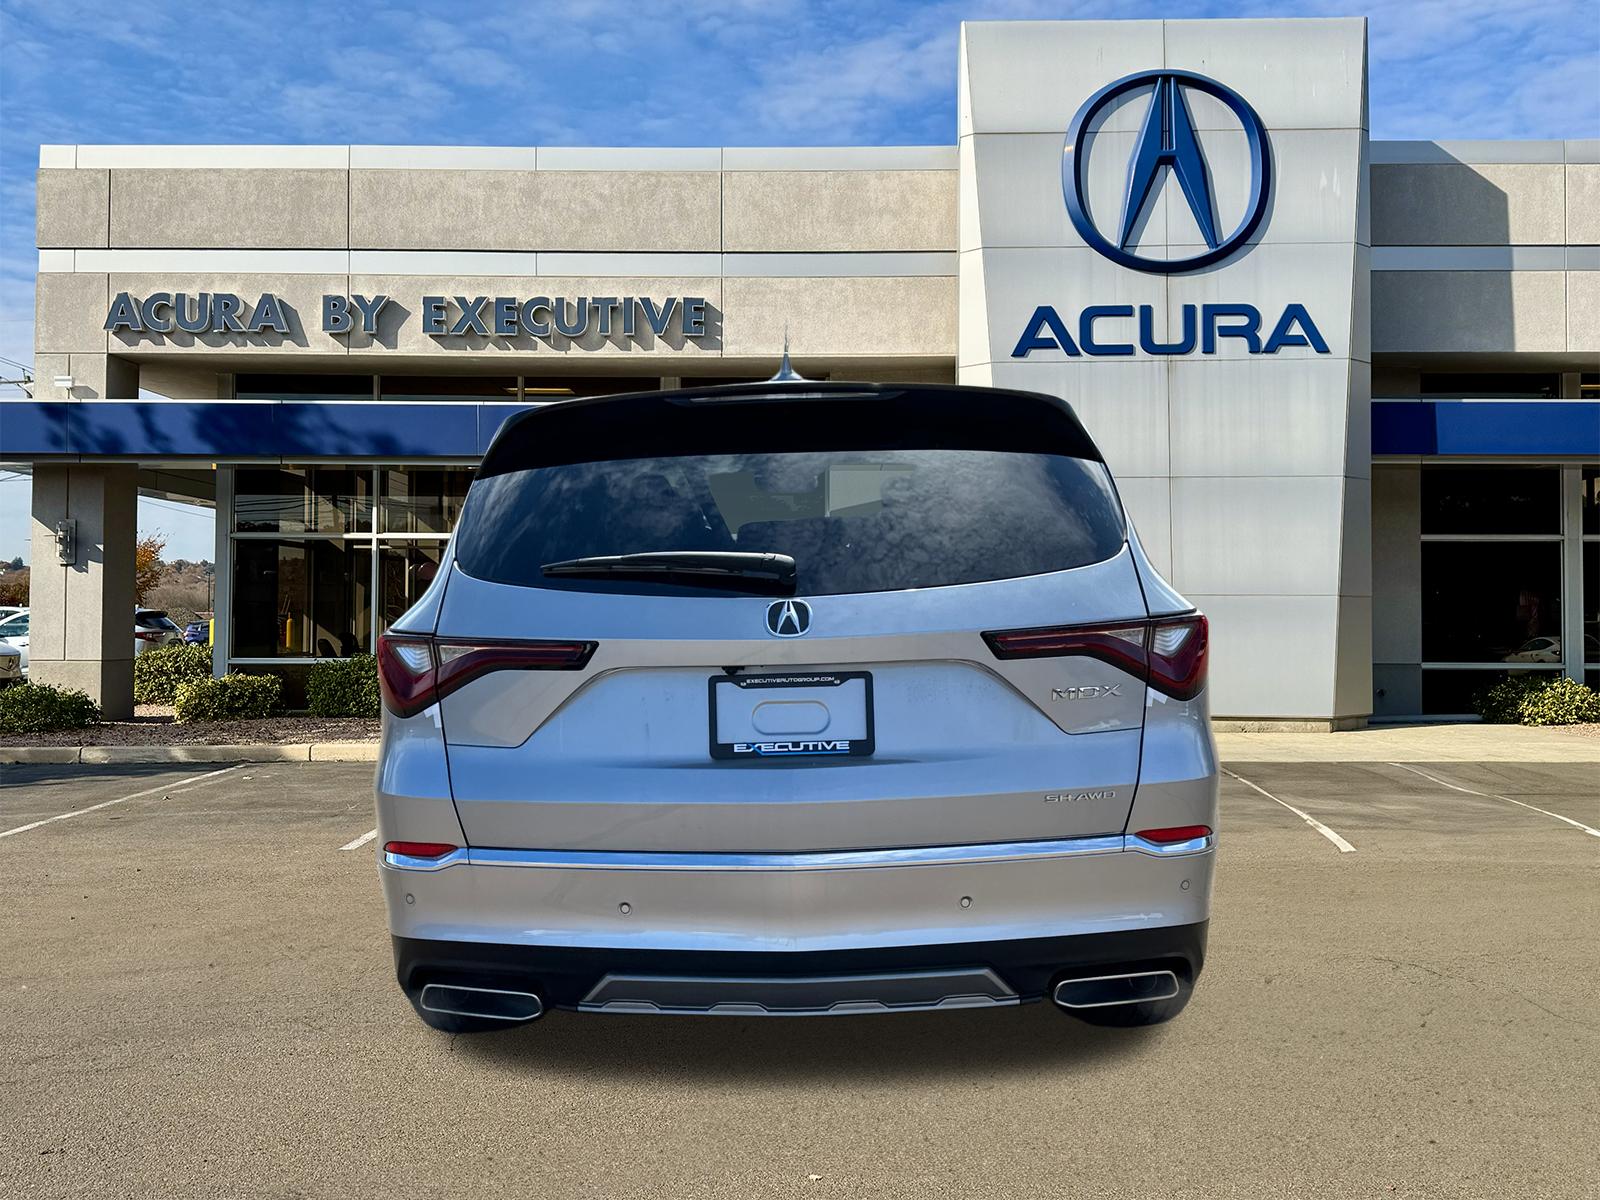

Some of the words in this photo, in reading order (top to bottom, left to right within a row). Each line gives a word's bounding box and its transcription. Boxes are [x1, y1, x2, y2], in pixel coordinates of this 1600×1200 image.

[104, 292, 289, 334] ACURA
[322, 294, 390, 335] BY
[422, 297, 707, 336] EXECUTIVE
[1011, 303, 1331, 357] ACURA
[746, 676, 835, 684] EXECUTIVEAUTOGROUP.COM
[1051, 684, 1122, 701] MDX
[733, 741, 850, 754] EXECUTIVE
